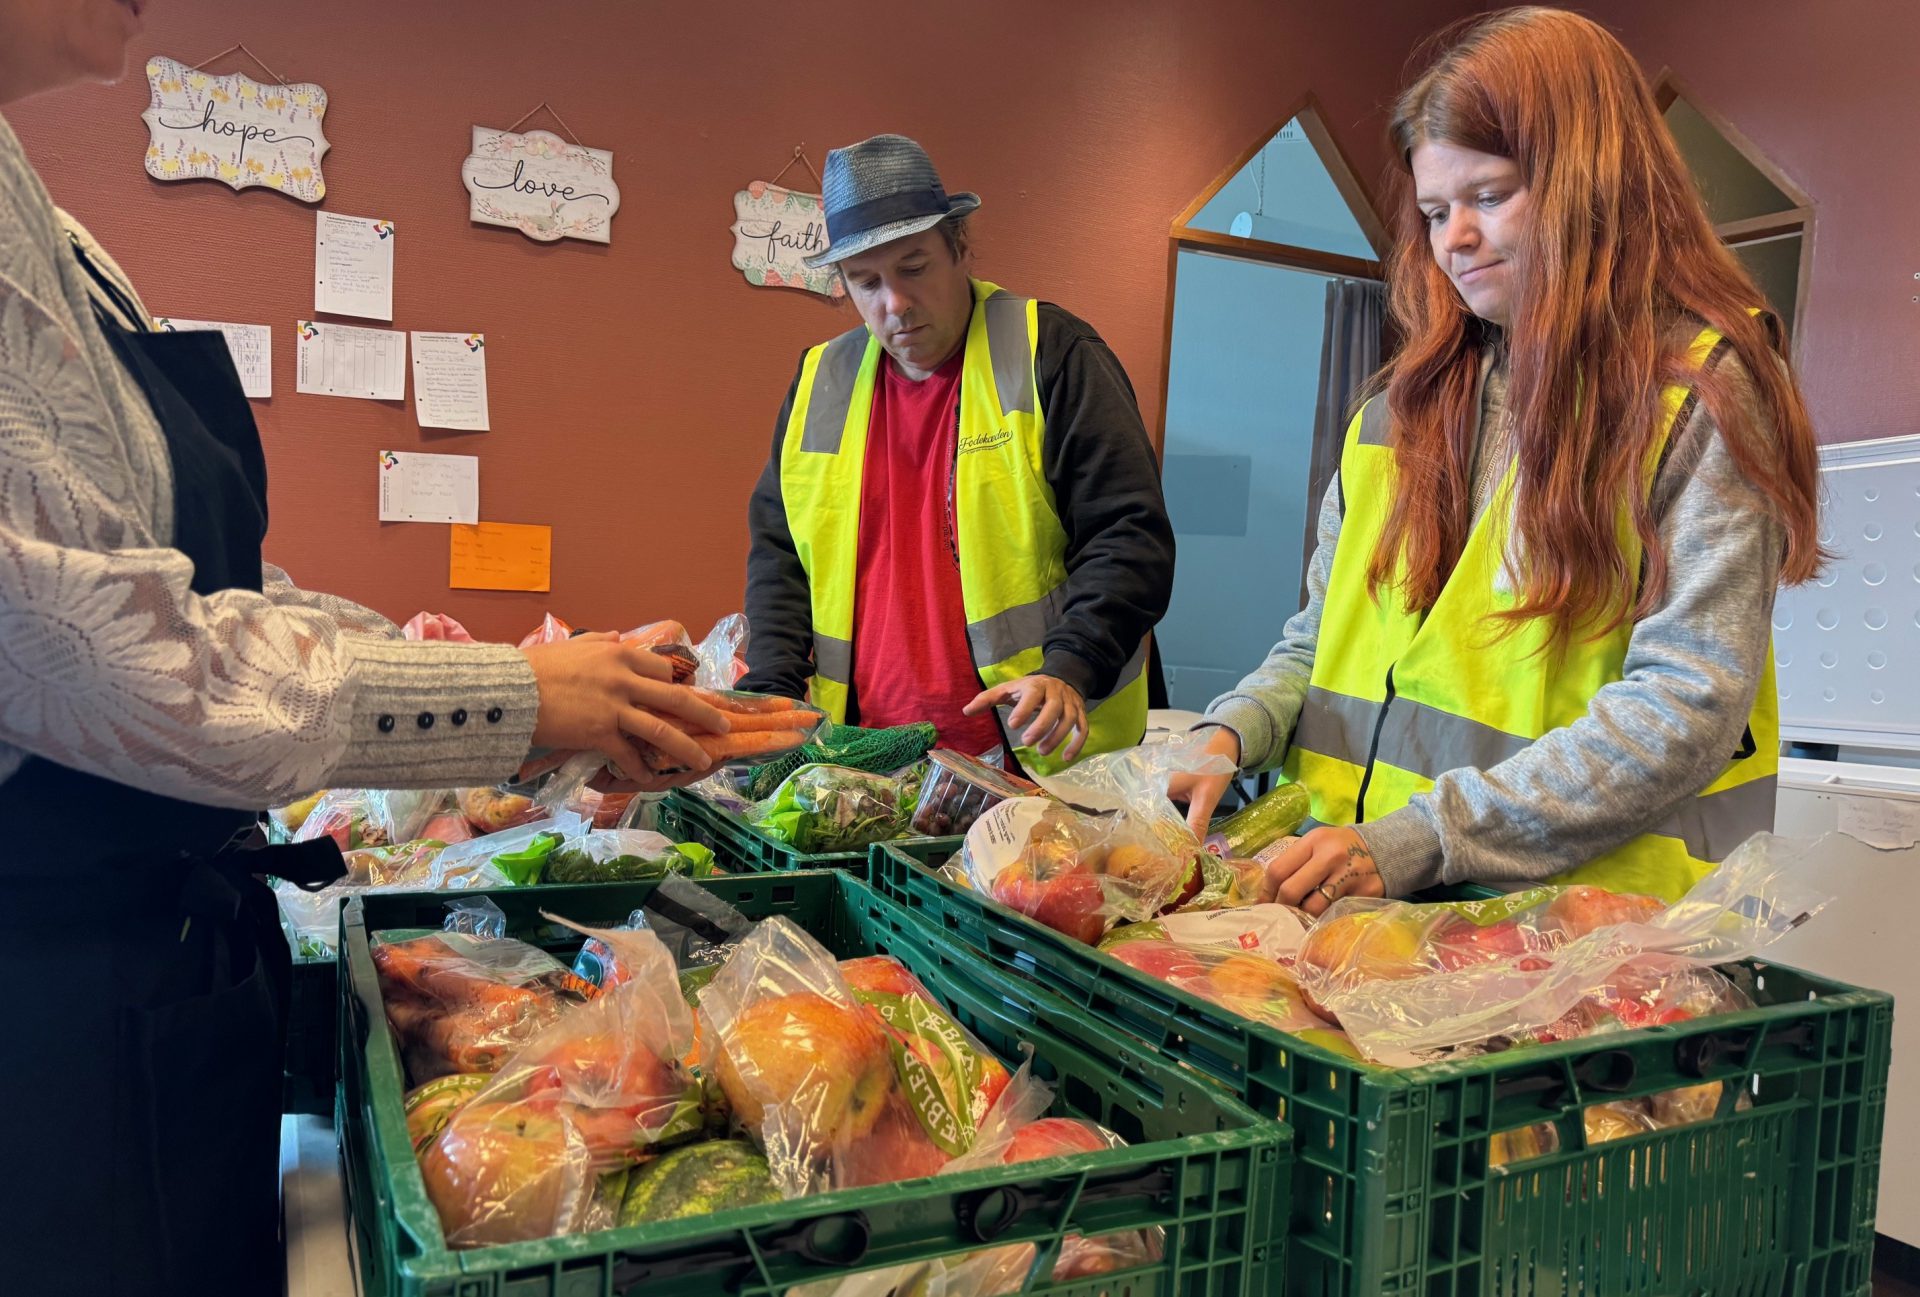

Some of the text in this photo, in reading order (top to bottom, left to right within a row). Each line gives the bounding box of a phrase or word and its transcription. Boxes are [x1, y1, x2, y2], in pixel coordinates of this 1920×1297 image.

[158, 99, 315, 164] hope
[473, 159, 610, 206] love
[740, 220, 824, 264] faith
